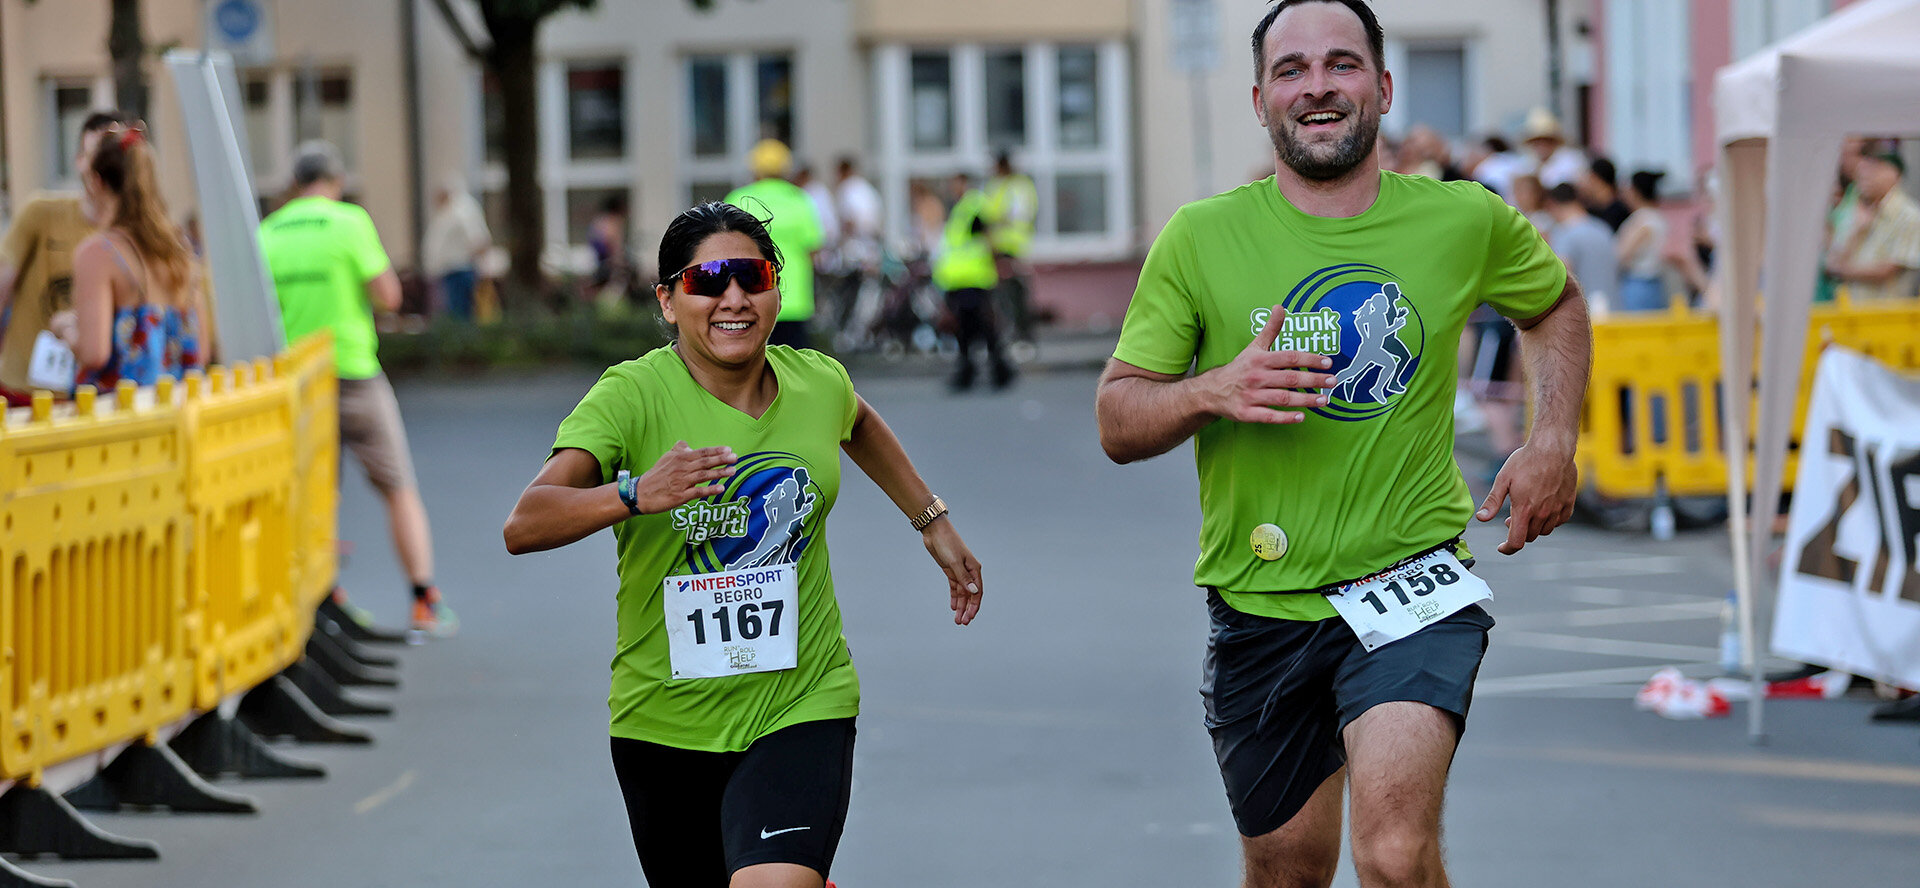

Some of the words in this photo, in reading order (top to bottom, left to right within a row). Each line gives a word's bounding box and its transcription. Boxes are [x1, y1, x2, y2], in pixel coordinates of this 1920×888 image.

[1254, 310, 1337, 332] Shunk
[691, 569, 783, 592] INTERSPORT
[1360, 563, 1460, 615] 1158
[714, 587, 763, 604] BEGRO
[1414, 602, 1440, 619] HELP
[687, 599, 784, 645] 1167
[730, 651, 756, 664] HELP
